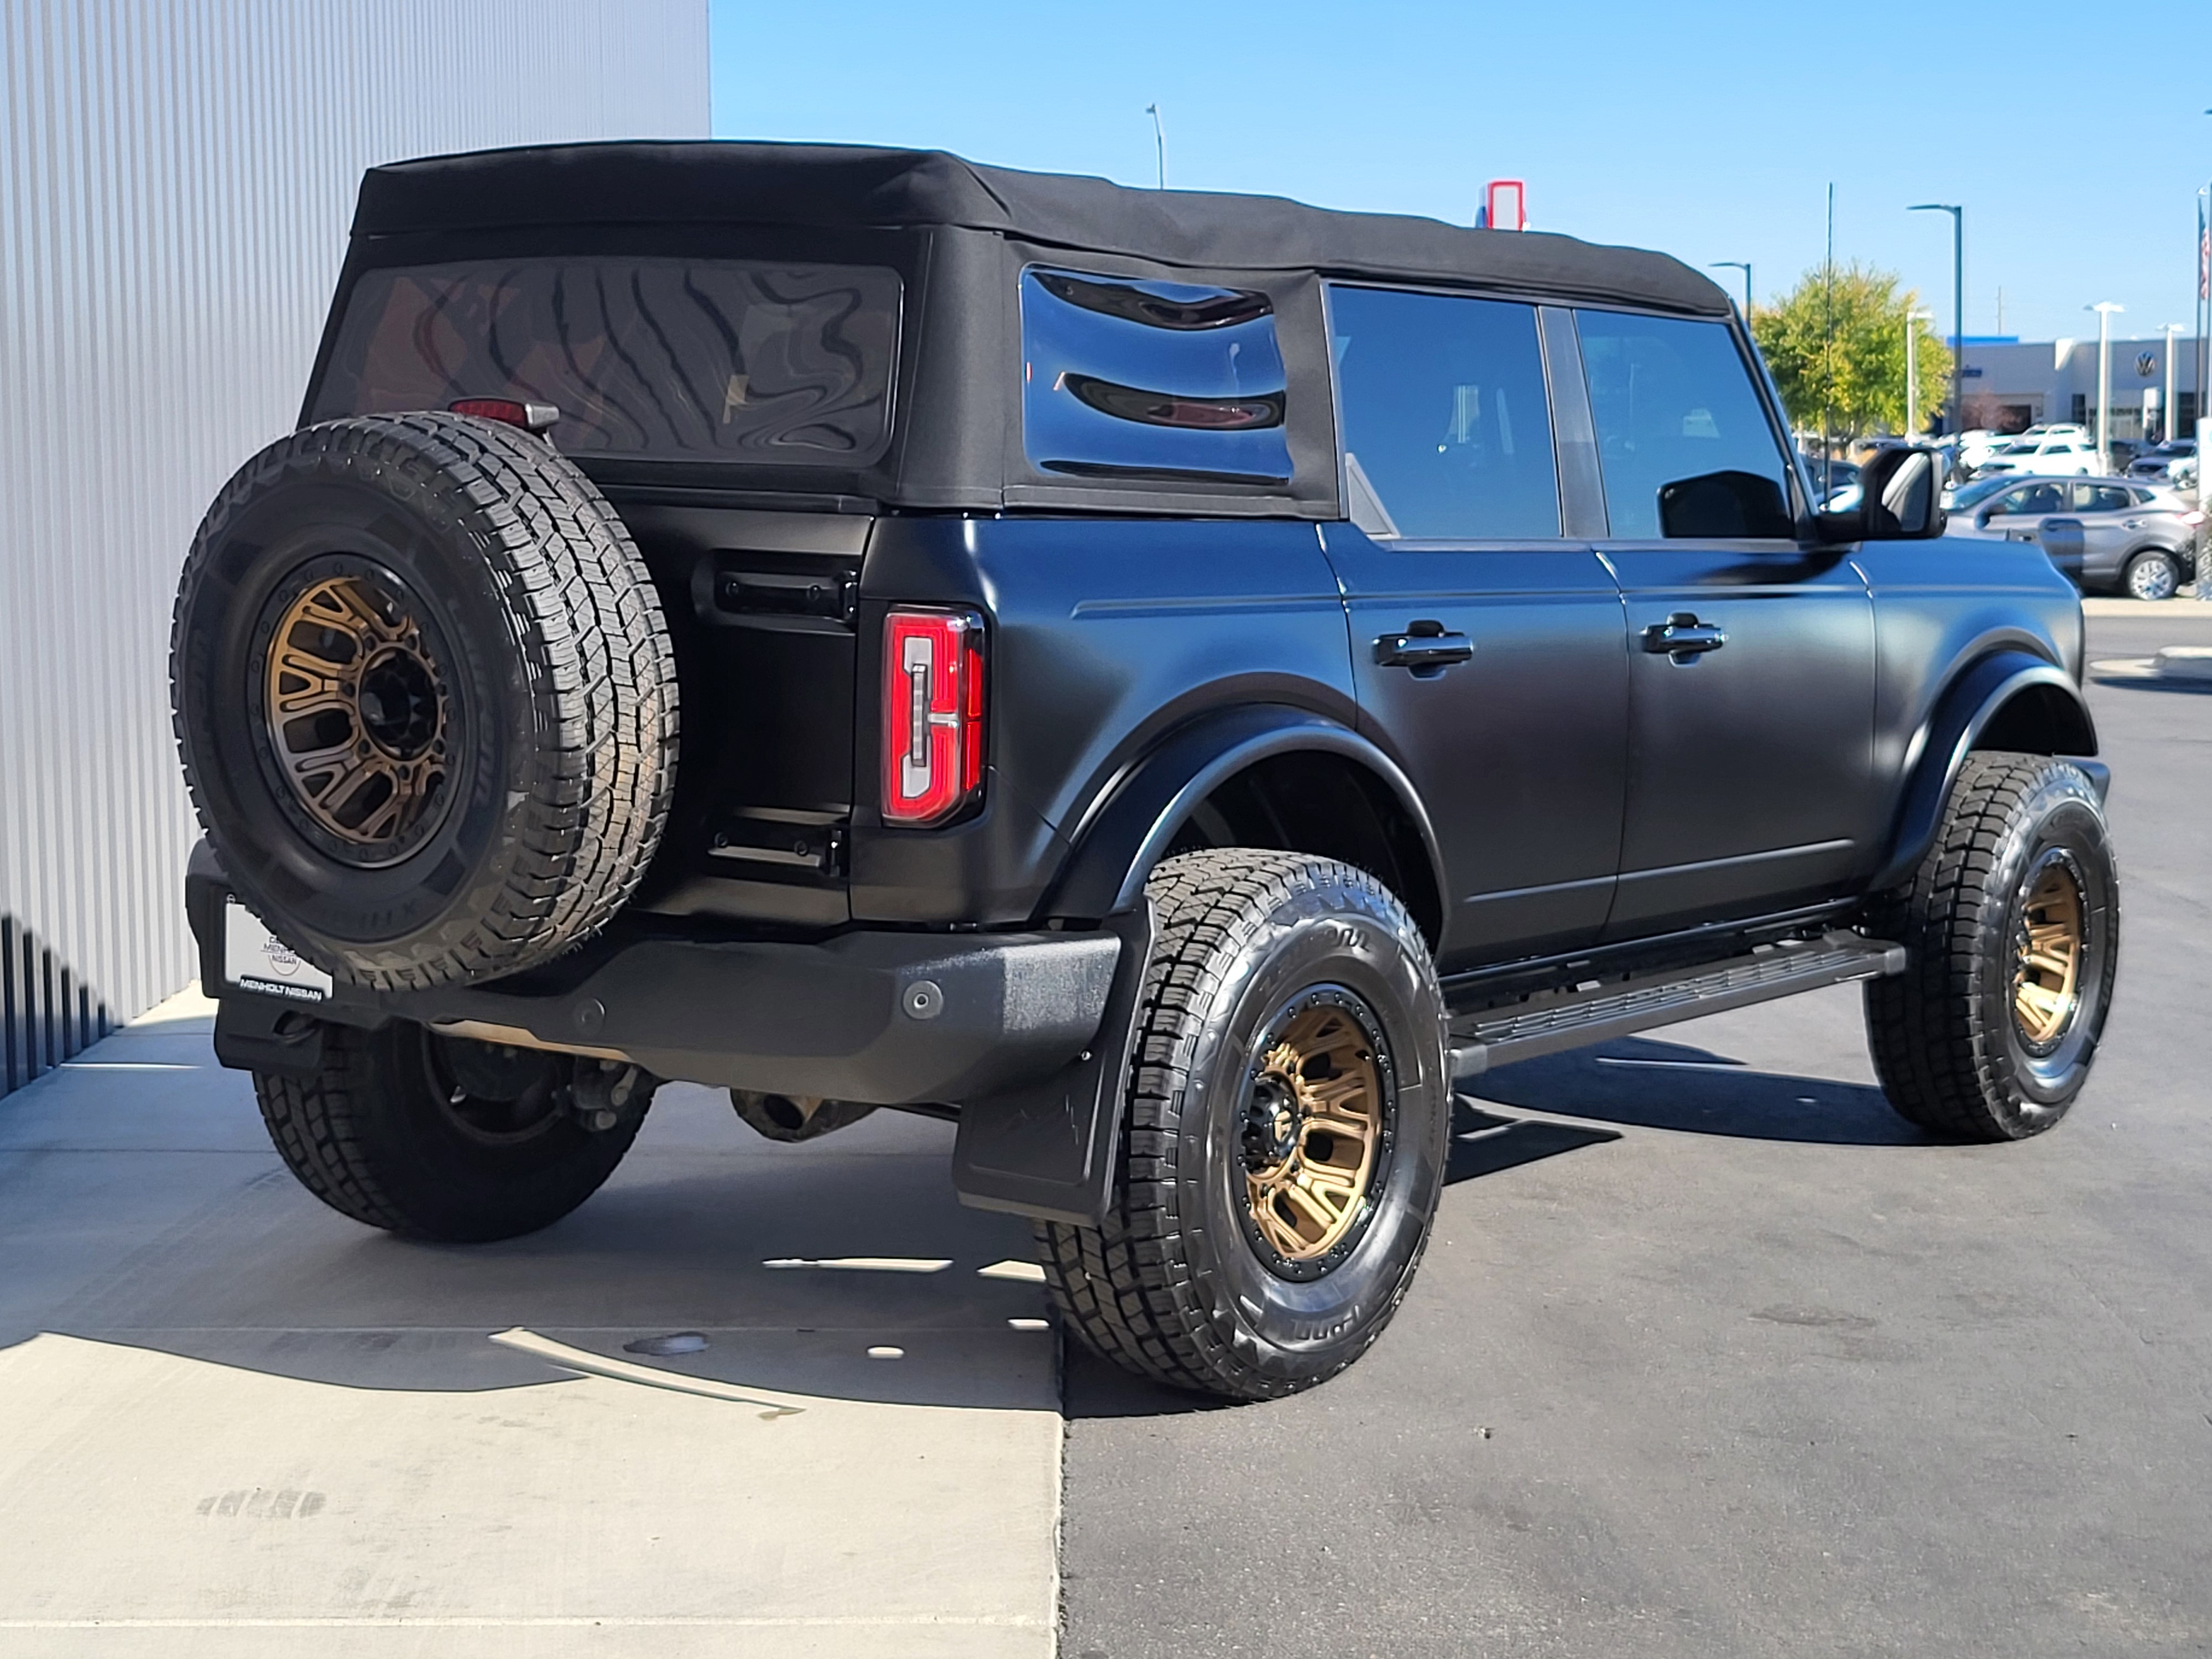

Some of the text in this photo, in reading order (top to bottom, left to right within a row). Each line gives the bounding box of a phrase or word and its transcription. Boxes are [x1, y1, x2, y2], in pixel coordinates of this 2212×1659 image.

[272, 954, 297, 965] NISSAN
[240, 978, 322, 1001] MENHOLT NISSAN
